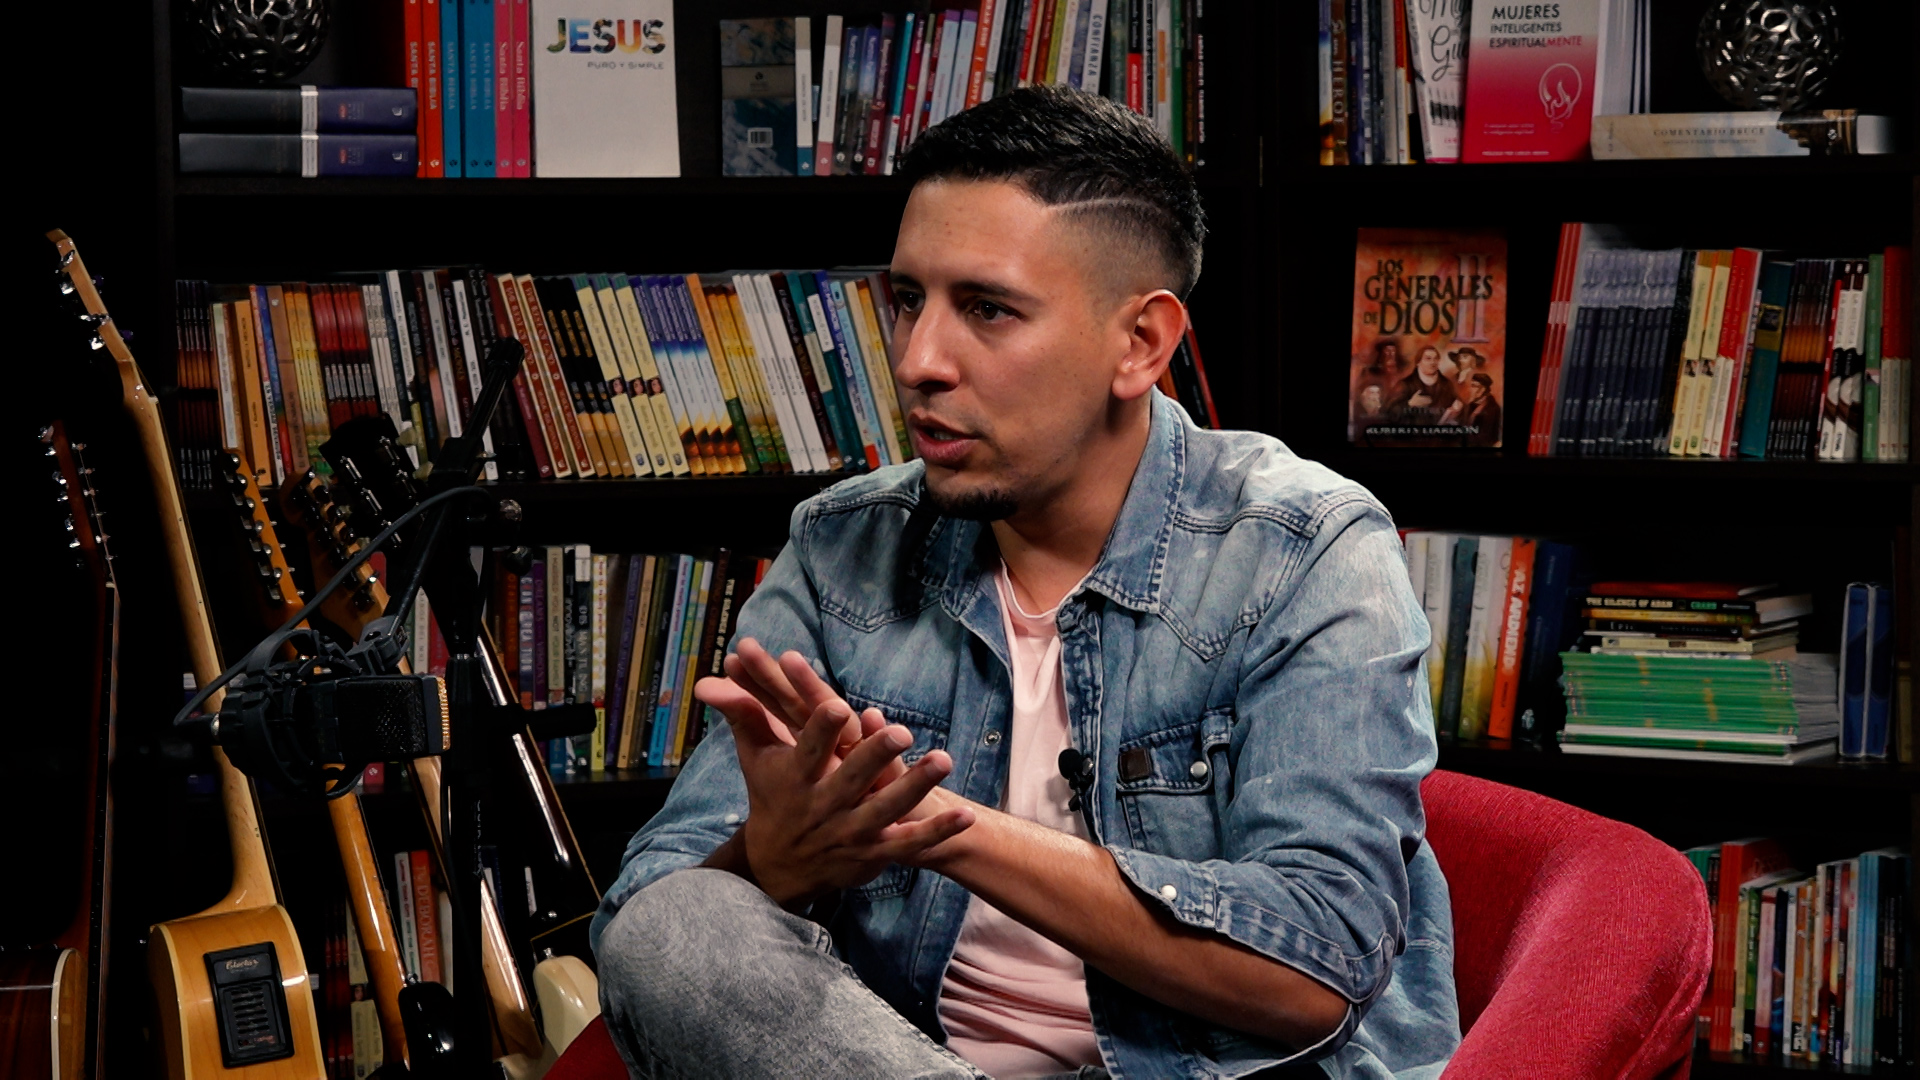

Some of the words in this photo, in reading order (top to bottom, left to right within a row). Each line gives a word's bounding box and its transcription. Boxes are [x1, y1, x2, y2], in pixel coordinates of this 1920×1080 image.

[1492, 4, 1560, 20] MUJERES
[546, 18, 665, 54] JESUS
[1490, 22, 1562, 34] INTELIGENTES
[1087, 14, 1103, 76] CONFIANZA
[1490, 36, 1582, 48] ESPIRITUALMENTE
[1653, 127, 1726, 137] COMENTARIO
[1729, 126, 1766, 136] BRUCE
[1378, 259, 1403, 275] LOS
[1364, 275, 1493, 300] GENERALES
[1364, 312, 1378, 324] DE
[1379, 300, 1455, 334] DIOS
[551, 615, 559, 632] NOT
[417, 884, 434, 958] DEBORAH
